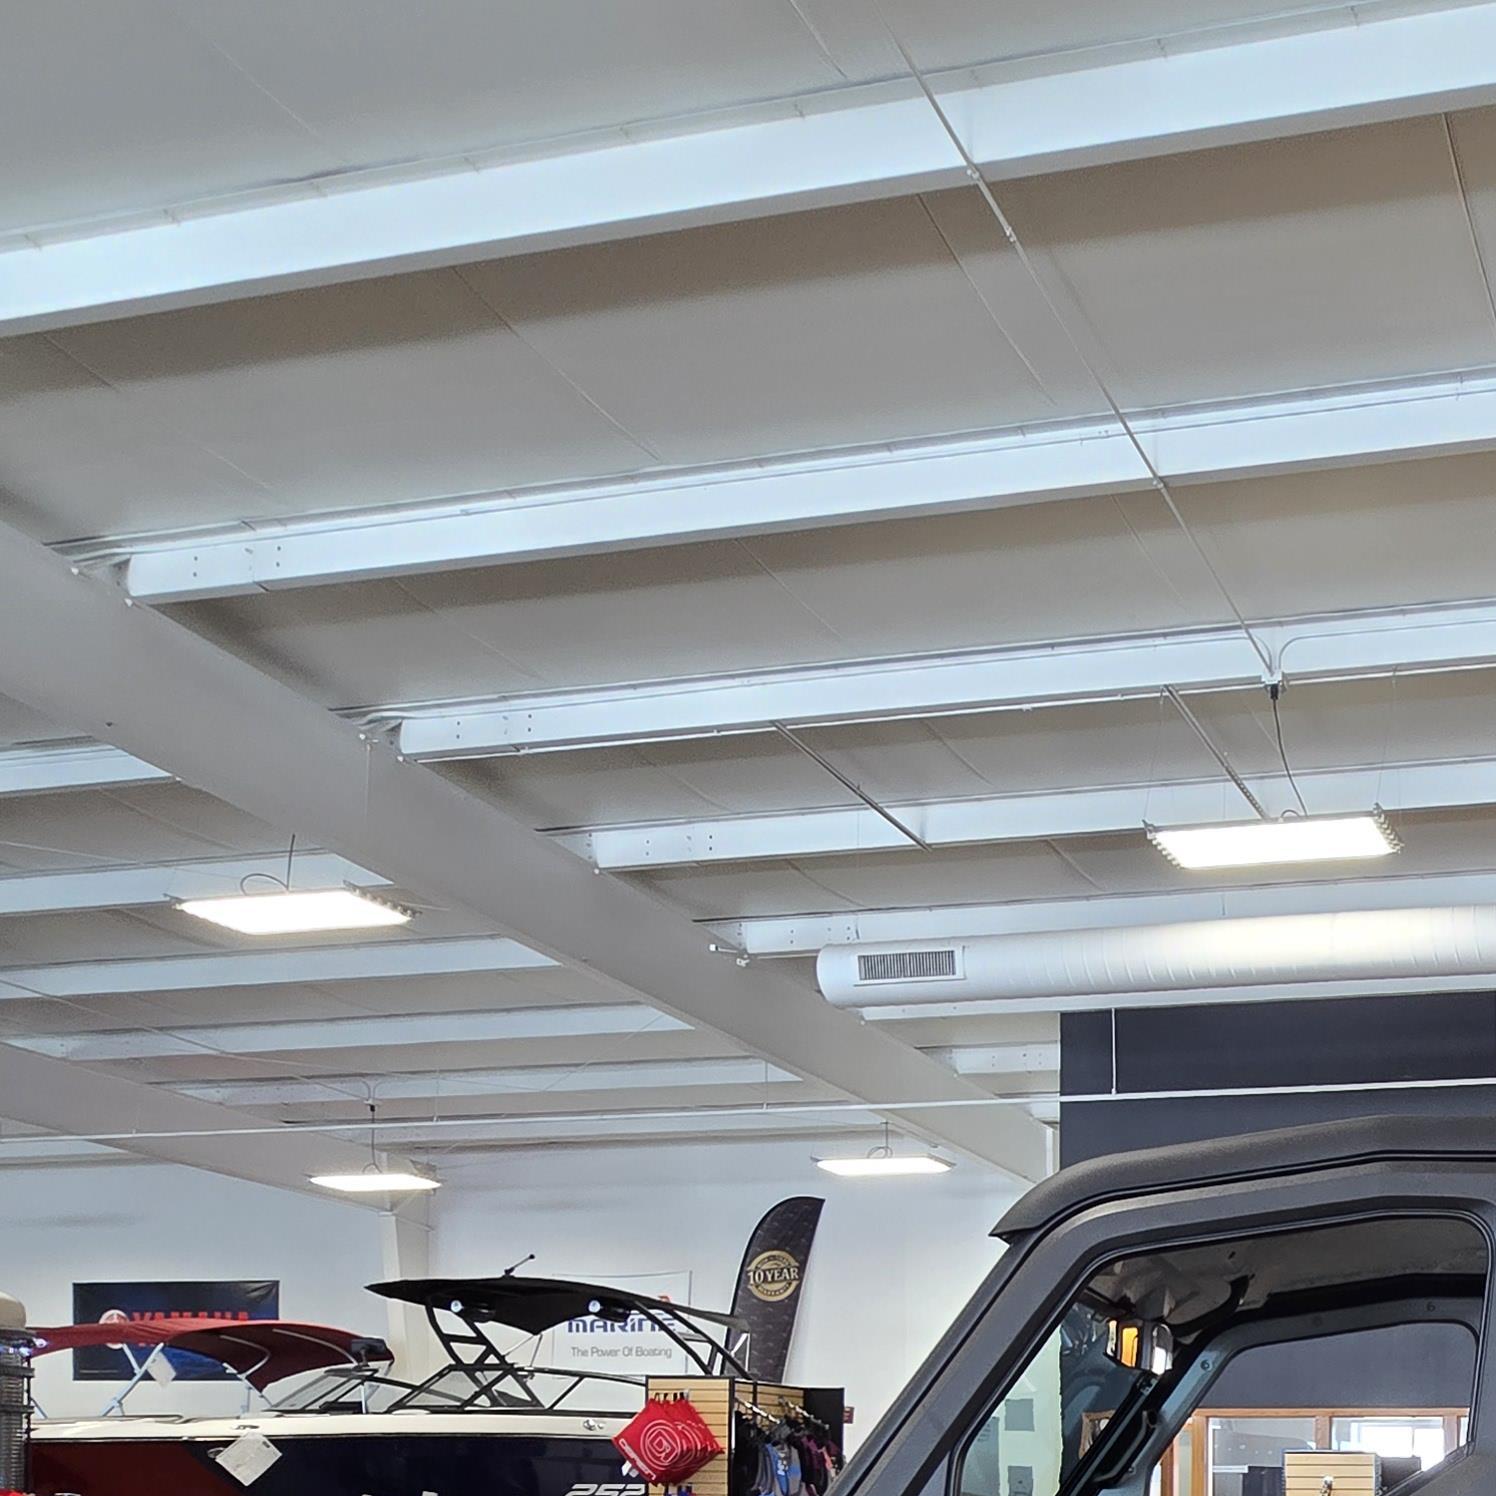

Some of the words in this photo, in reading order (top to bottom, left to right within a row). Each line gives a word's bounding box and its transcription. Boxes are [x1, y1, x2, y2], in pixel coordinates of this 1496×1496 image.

[747, 1269, 764, 1285] 10
[765, 1267, 799, 1282] YEAR
[571, 1346, 589, 1357] The
[590, 1346, 621, 1357] Power
[635, 1346, 673, 1359] Boating
